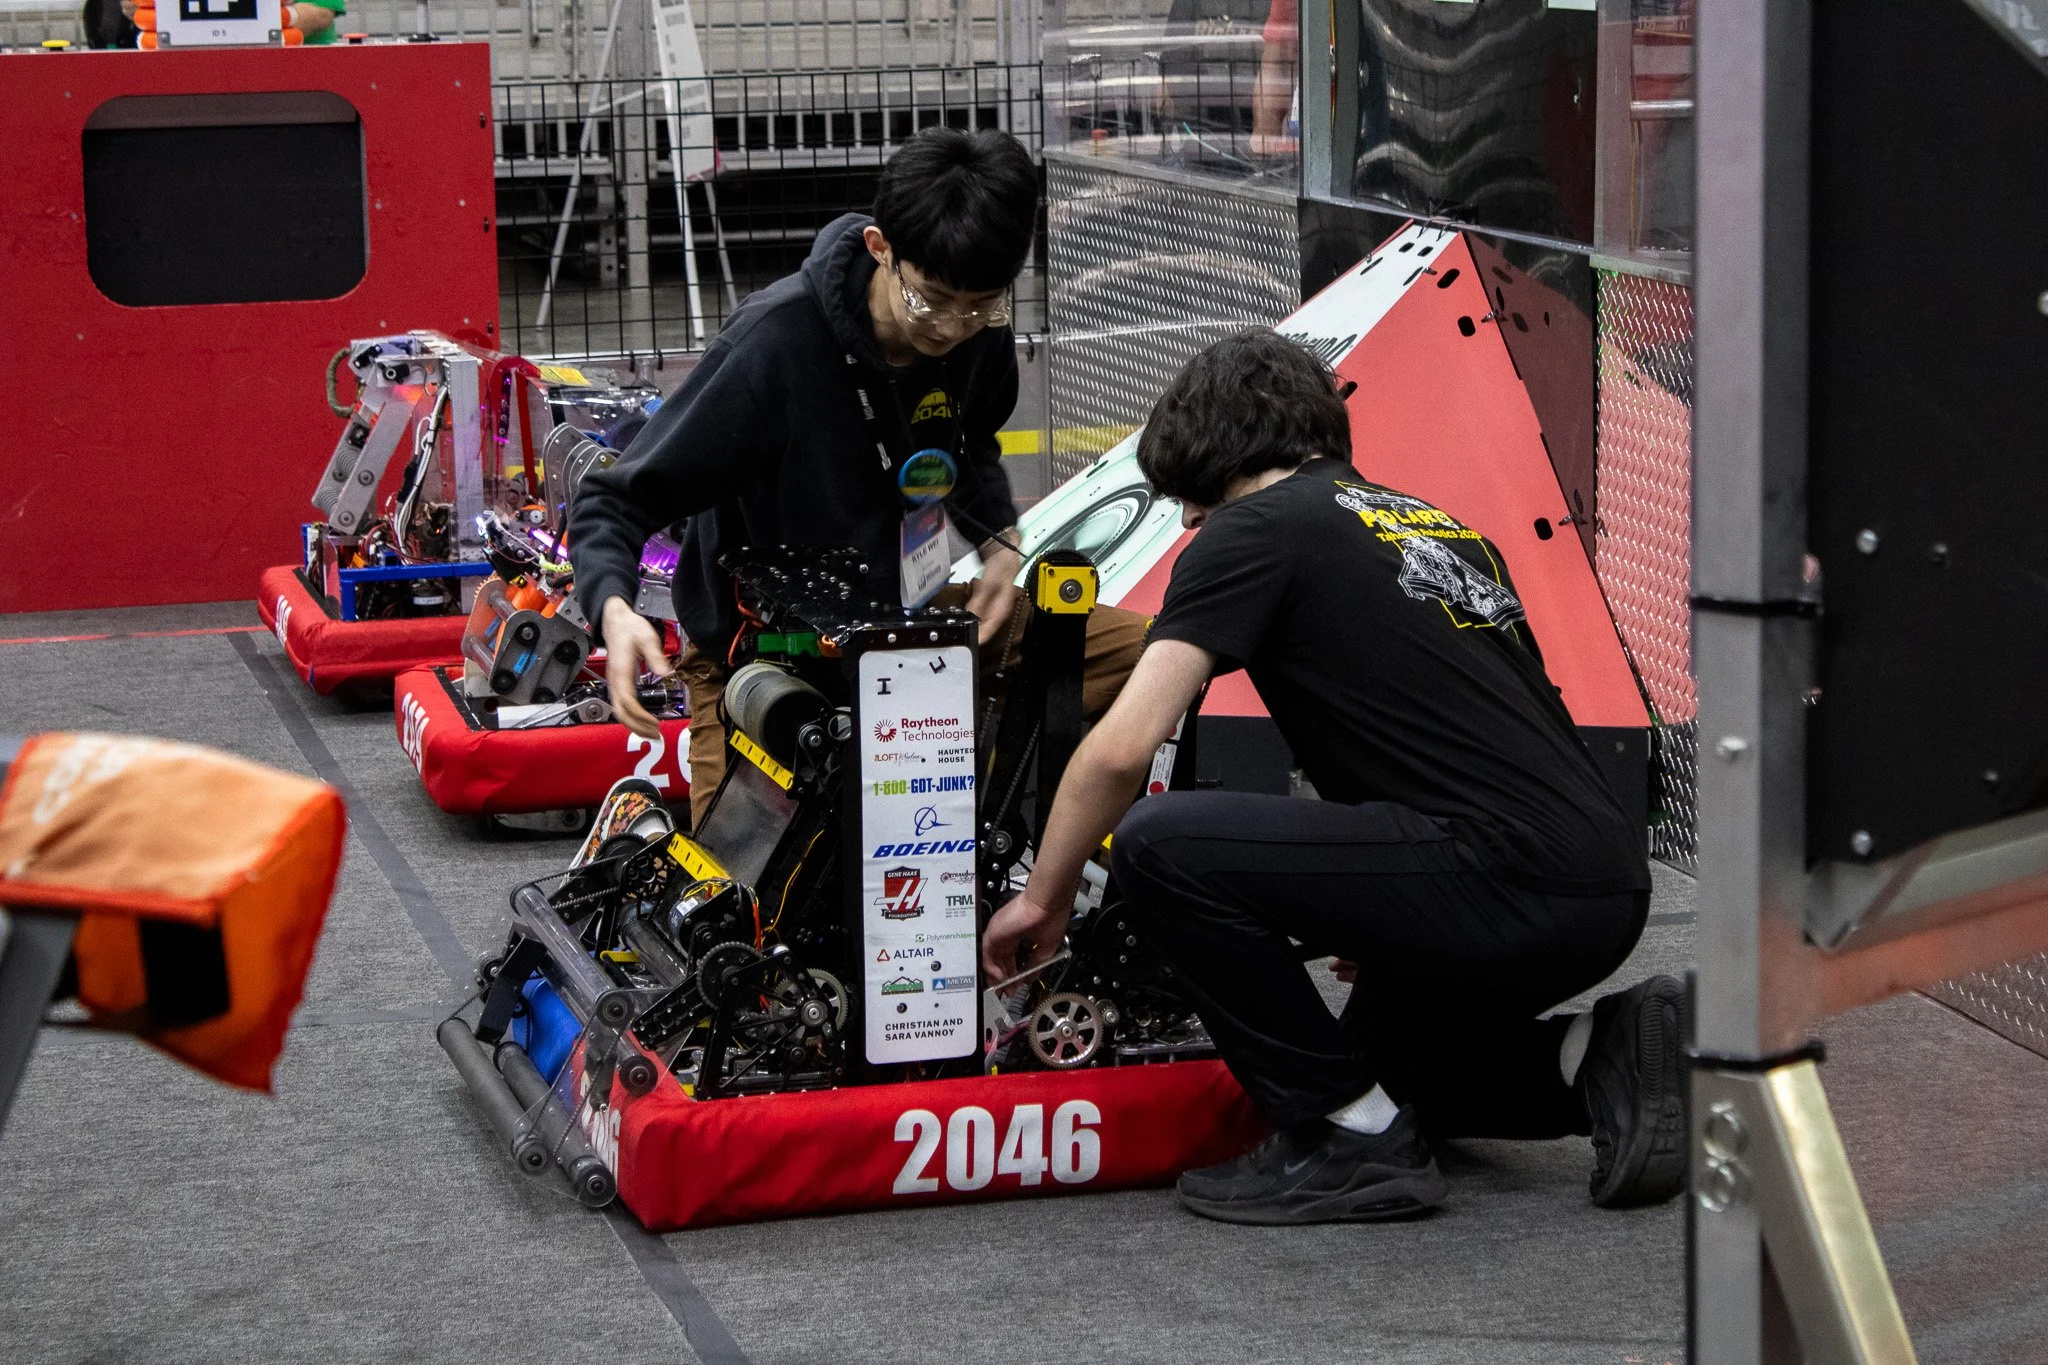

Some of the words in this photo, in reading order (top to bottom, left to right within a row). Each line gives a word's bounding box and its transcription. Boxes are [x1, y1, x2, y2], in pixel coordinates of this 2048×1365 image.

[901, 717, 959, 730] Raytheon
[903, 729, 975, 742] Technologies
[938, 748, 974, 756] HAUNTED
[938, 756, 965, 764] HOUSE
[874, 776, 975, 796] 1-800-GOT-JUNK?
[872, 839, 976, 859] BOEING
[893, 947, 934, 960] ALTAIR
[947, 977, 972, 985] METAL
[885, 1020, 940, 1031] CHRISTIAN
[942, 1018, 964, 1027] AND
[885, 1032, 912, 1041] SARA
[914, 1028, 955, 1039] VANNOY
[892, 1099, 1102, 1196] 2046
